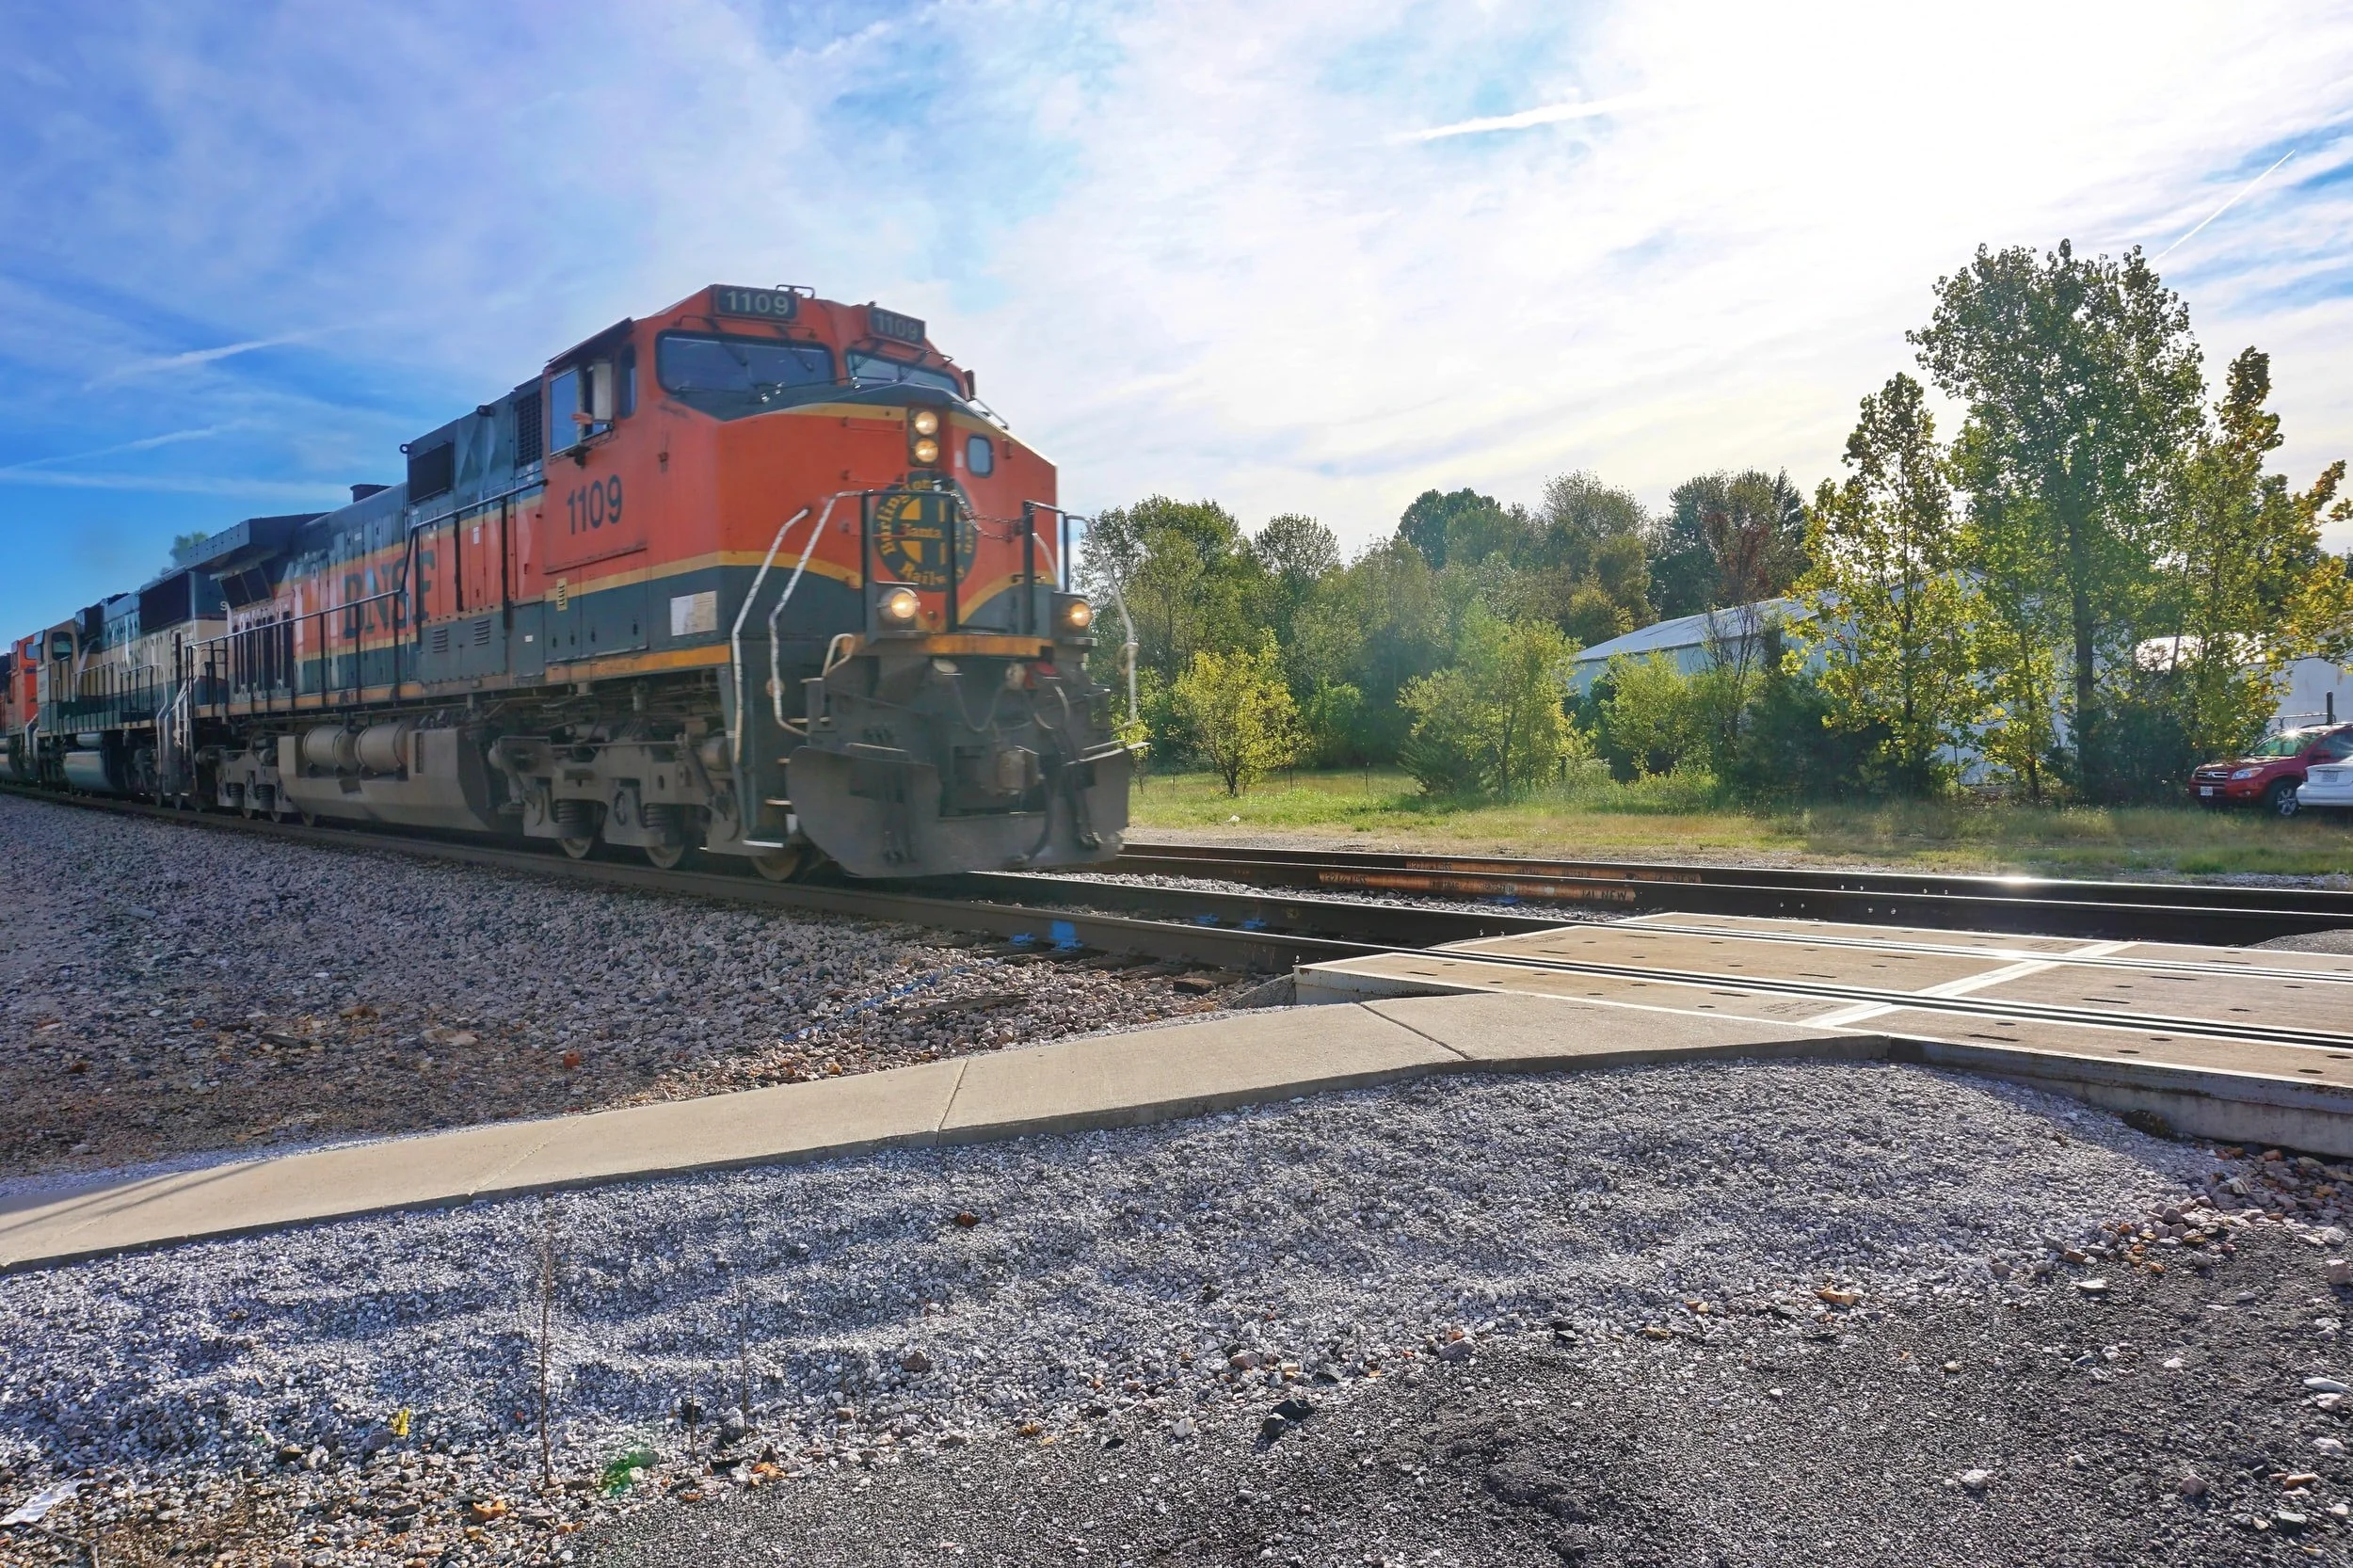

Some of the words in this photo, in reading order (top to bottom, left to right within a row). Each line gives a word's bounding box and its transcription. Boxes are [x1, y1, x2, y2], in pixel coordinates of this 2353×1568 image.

[727, 290, 790, 315] 1109
[877, 313, 919, 341] 1109
[567, 473, 623, 536] 1109
[343, 548, 436, 640] BNSF
